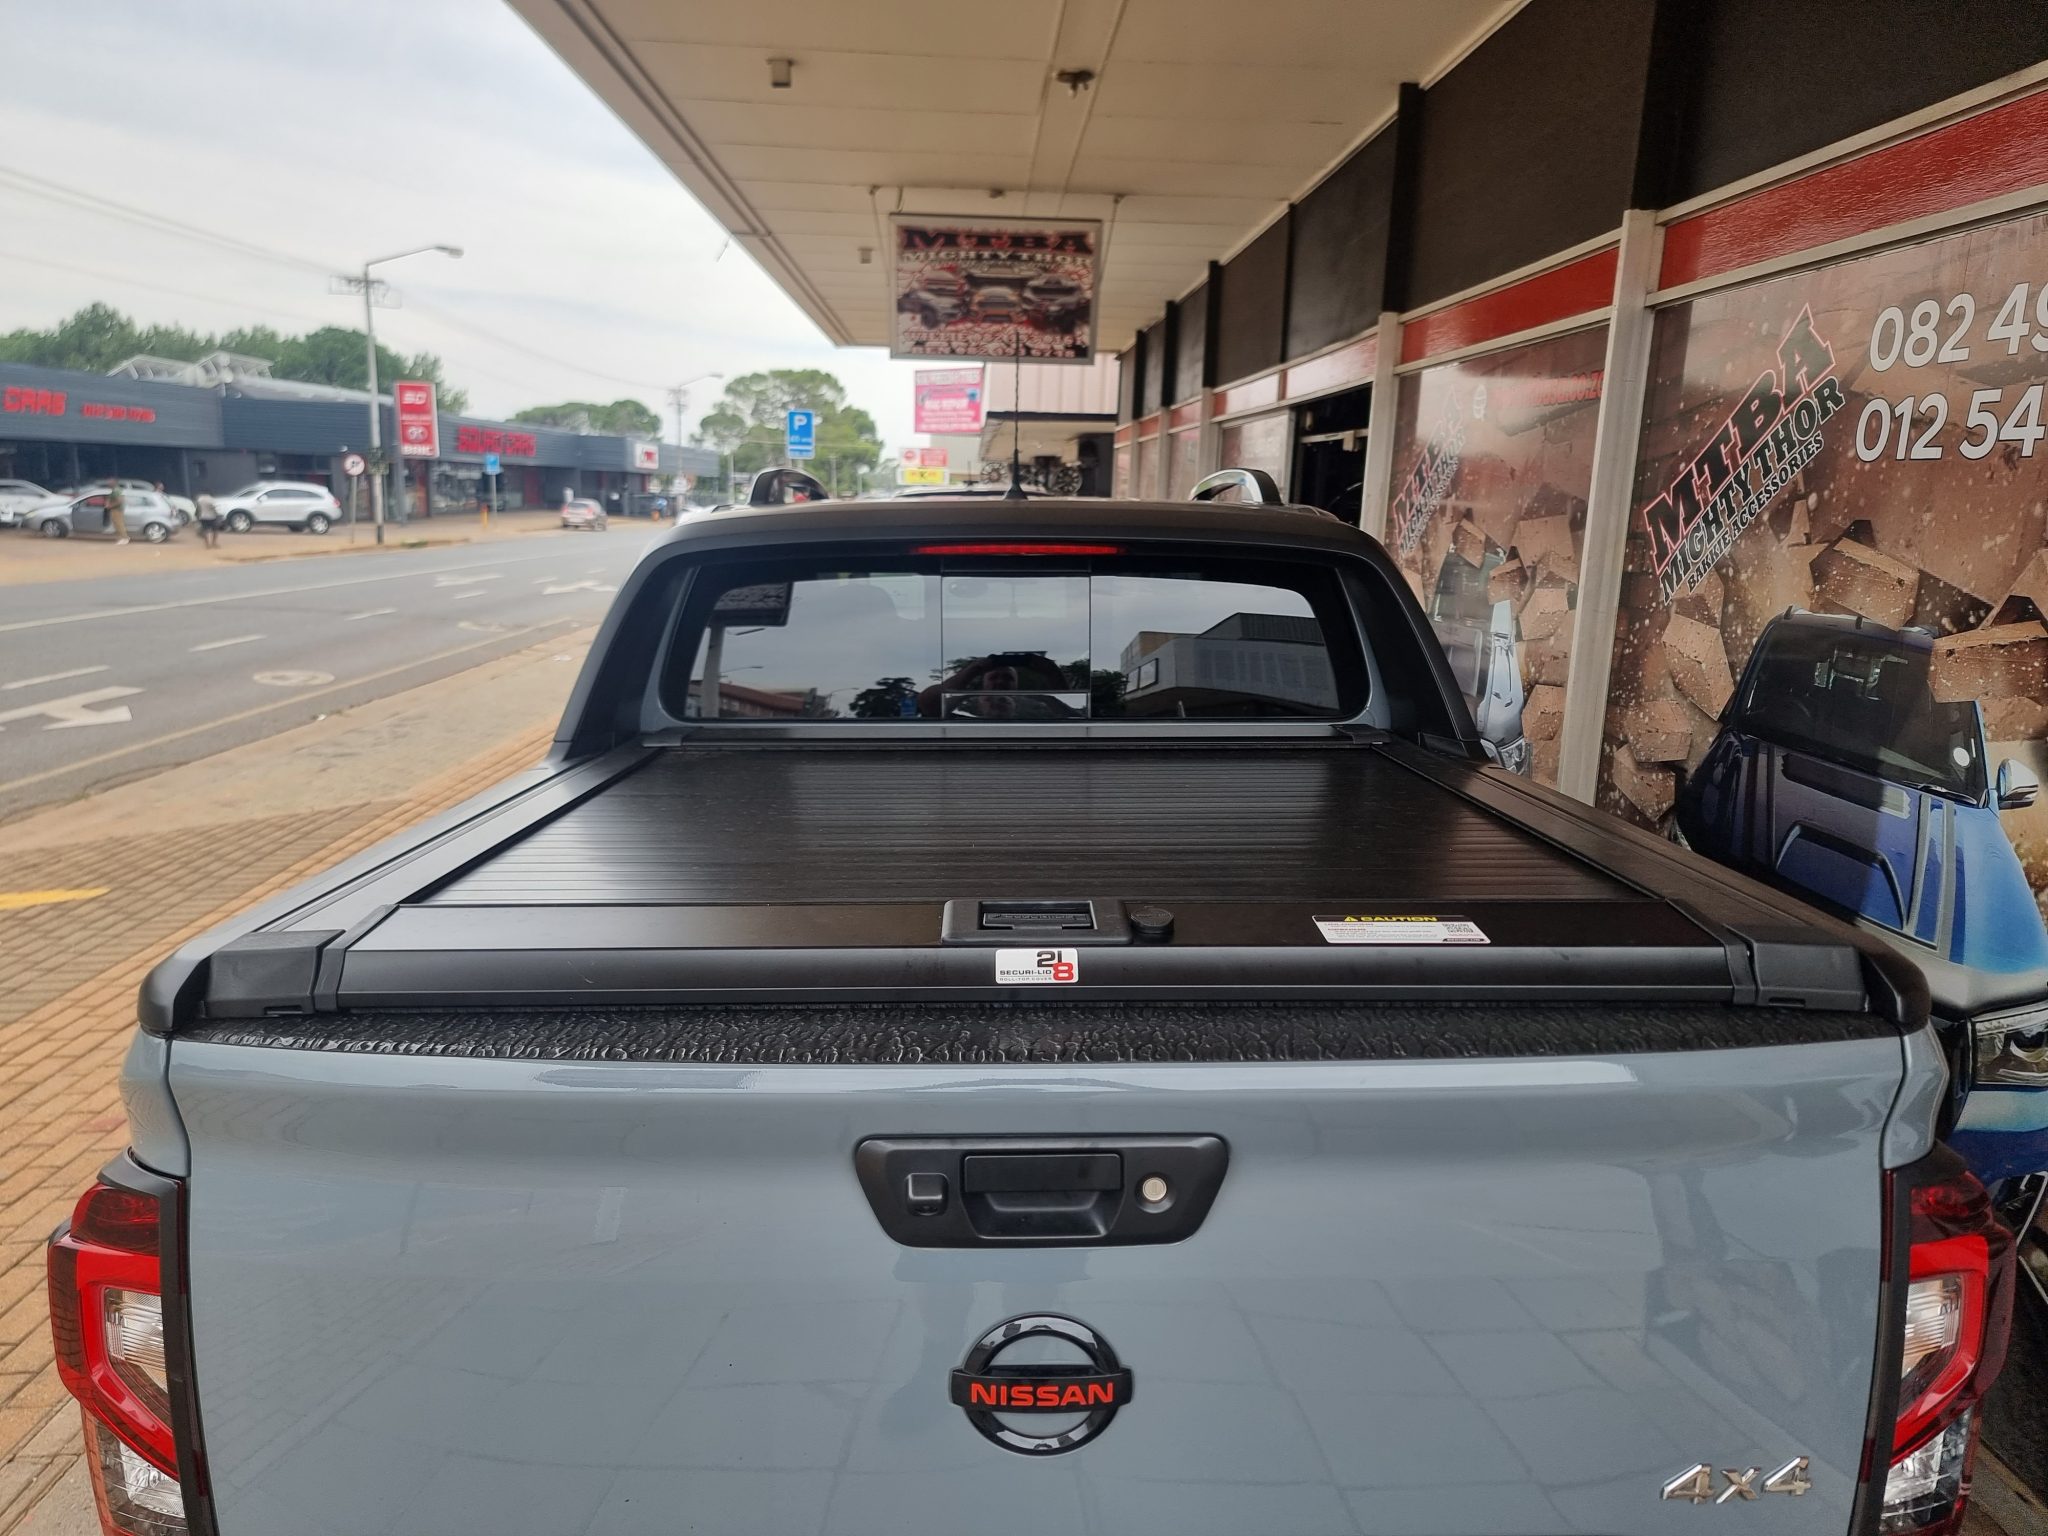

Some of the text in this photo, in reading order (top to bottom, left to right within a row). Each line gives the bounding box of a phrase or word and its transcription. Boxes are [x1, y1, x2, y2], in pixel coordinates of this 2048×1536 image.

[902, 250, 1012, 263] MIGHTY
[1869, 292, 1976, 373] 082
[1643, 302, 1836, 576] MTBA
[1855, 384, 2047, 462] 012 54
[1659, 375, 1845, 605] MIGHTY THOR
[1686, 430, 1824, 594] BAKKIE ACCESSORIES
[970, 1382, 1115, 1407] NISSAN
